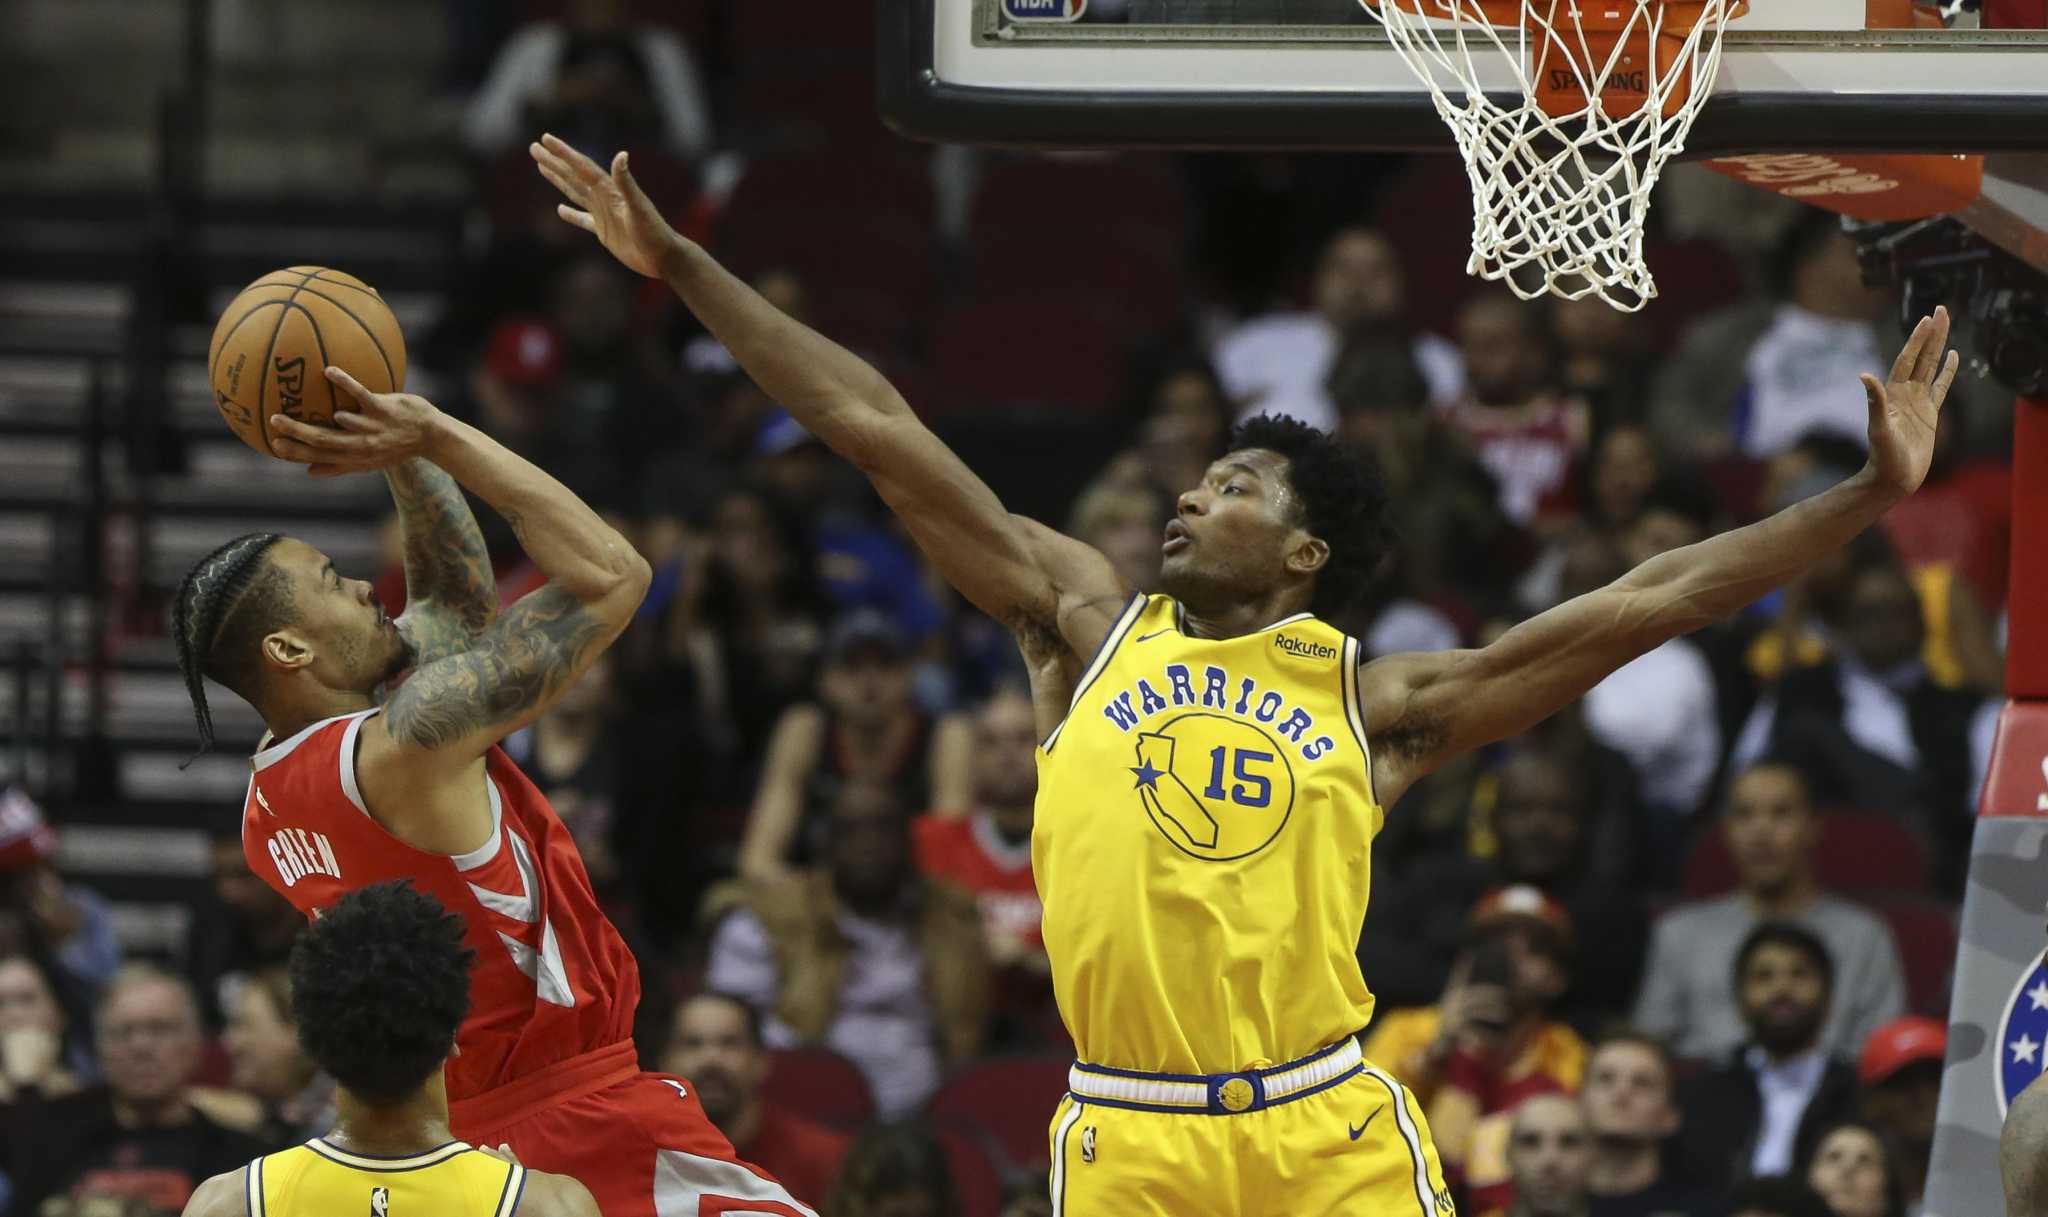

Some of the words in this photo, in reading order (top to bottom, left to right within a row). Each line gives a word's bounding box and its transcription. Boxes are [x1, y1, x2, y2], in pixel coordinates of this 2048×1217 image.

[1275, 633, 1337, 660] Rakuten
[1103, 663, 1335, 762] WARRIORS
[1204, 746, 1274, 808] 15
[268, 828, 341, 887] GREEN
